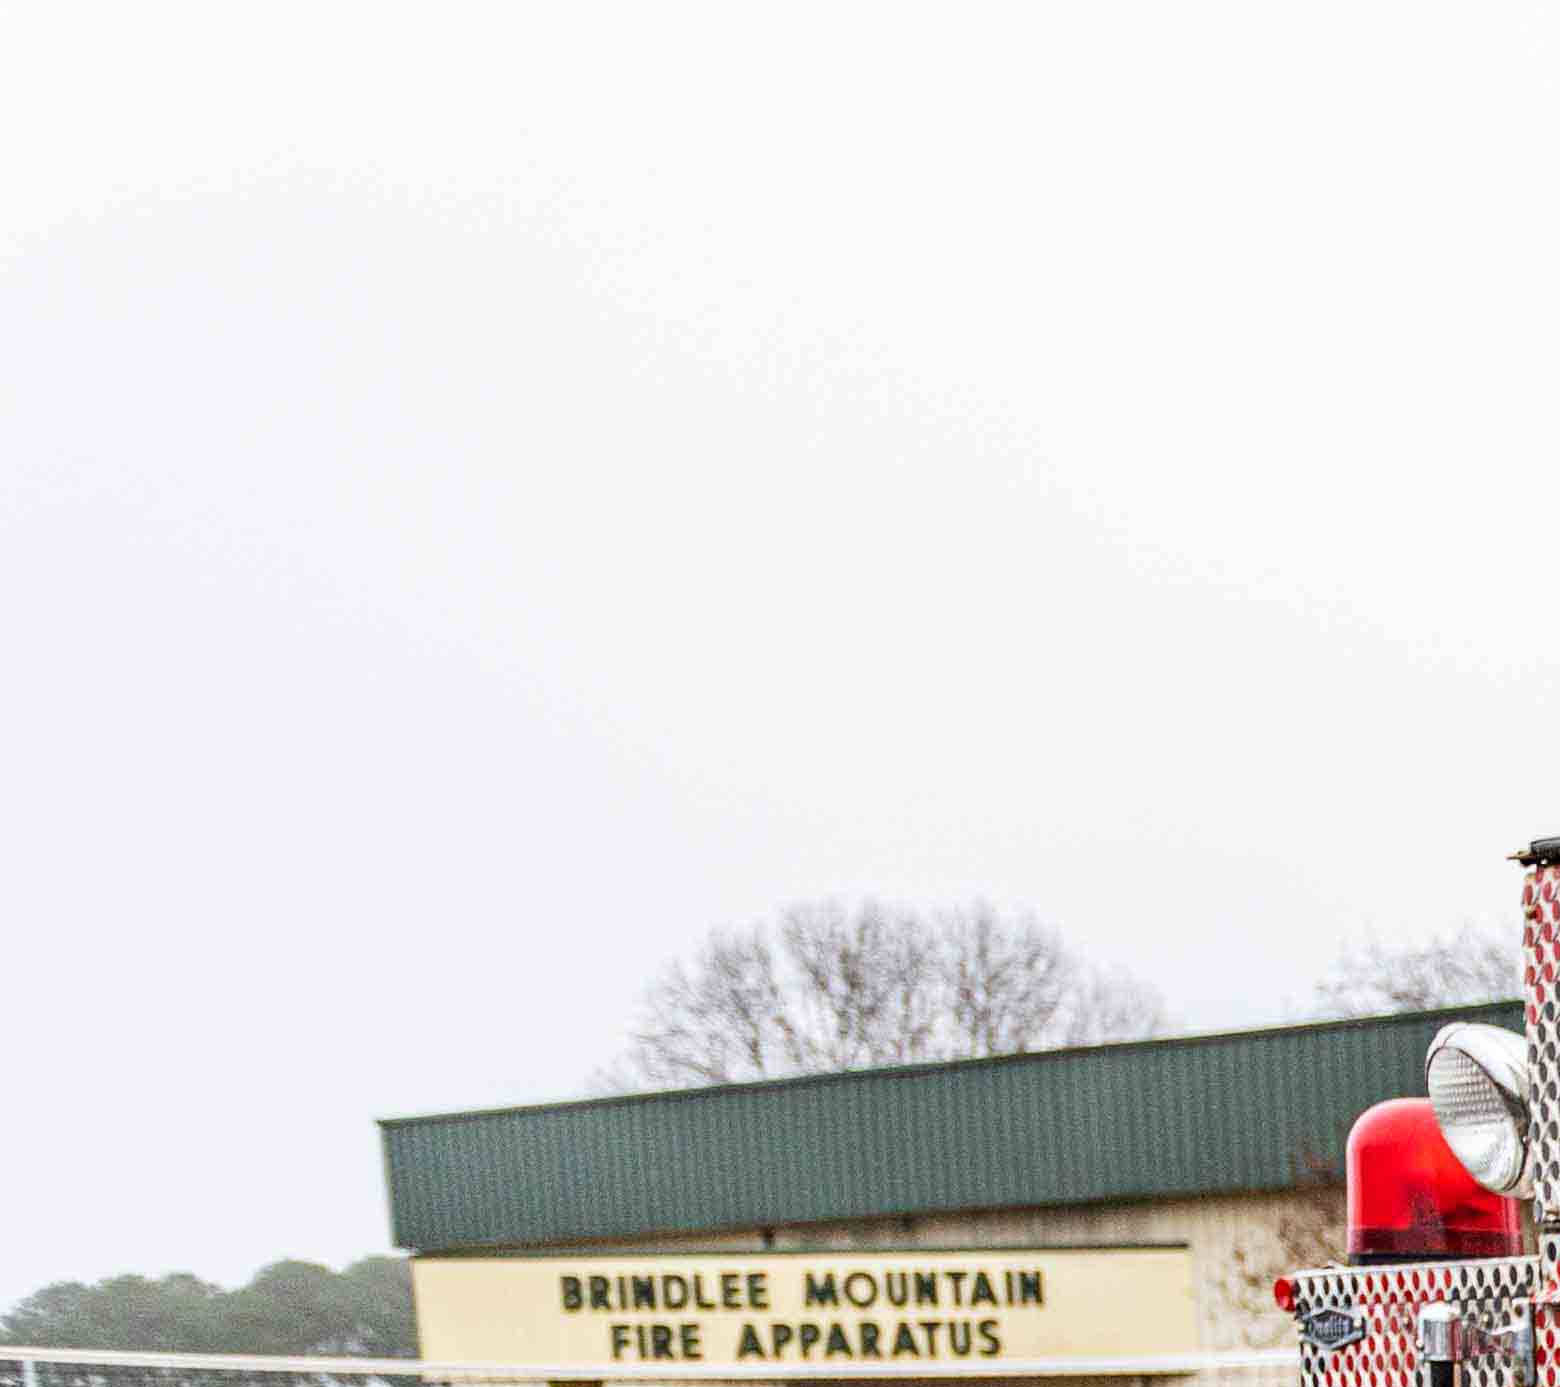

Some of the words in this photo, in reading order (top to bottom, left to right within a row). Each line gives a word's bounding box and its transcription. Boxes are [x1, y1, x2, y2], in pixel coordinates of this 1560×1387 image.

[560, 1275, 769, 1311] BRINDLEE
[804, 1271, 1045, 1308] MOUNTAIN
[612, 1323, 702, 1360] FIRE
[737, 1320, 1003, 1360] APPARATUS
